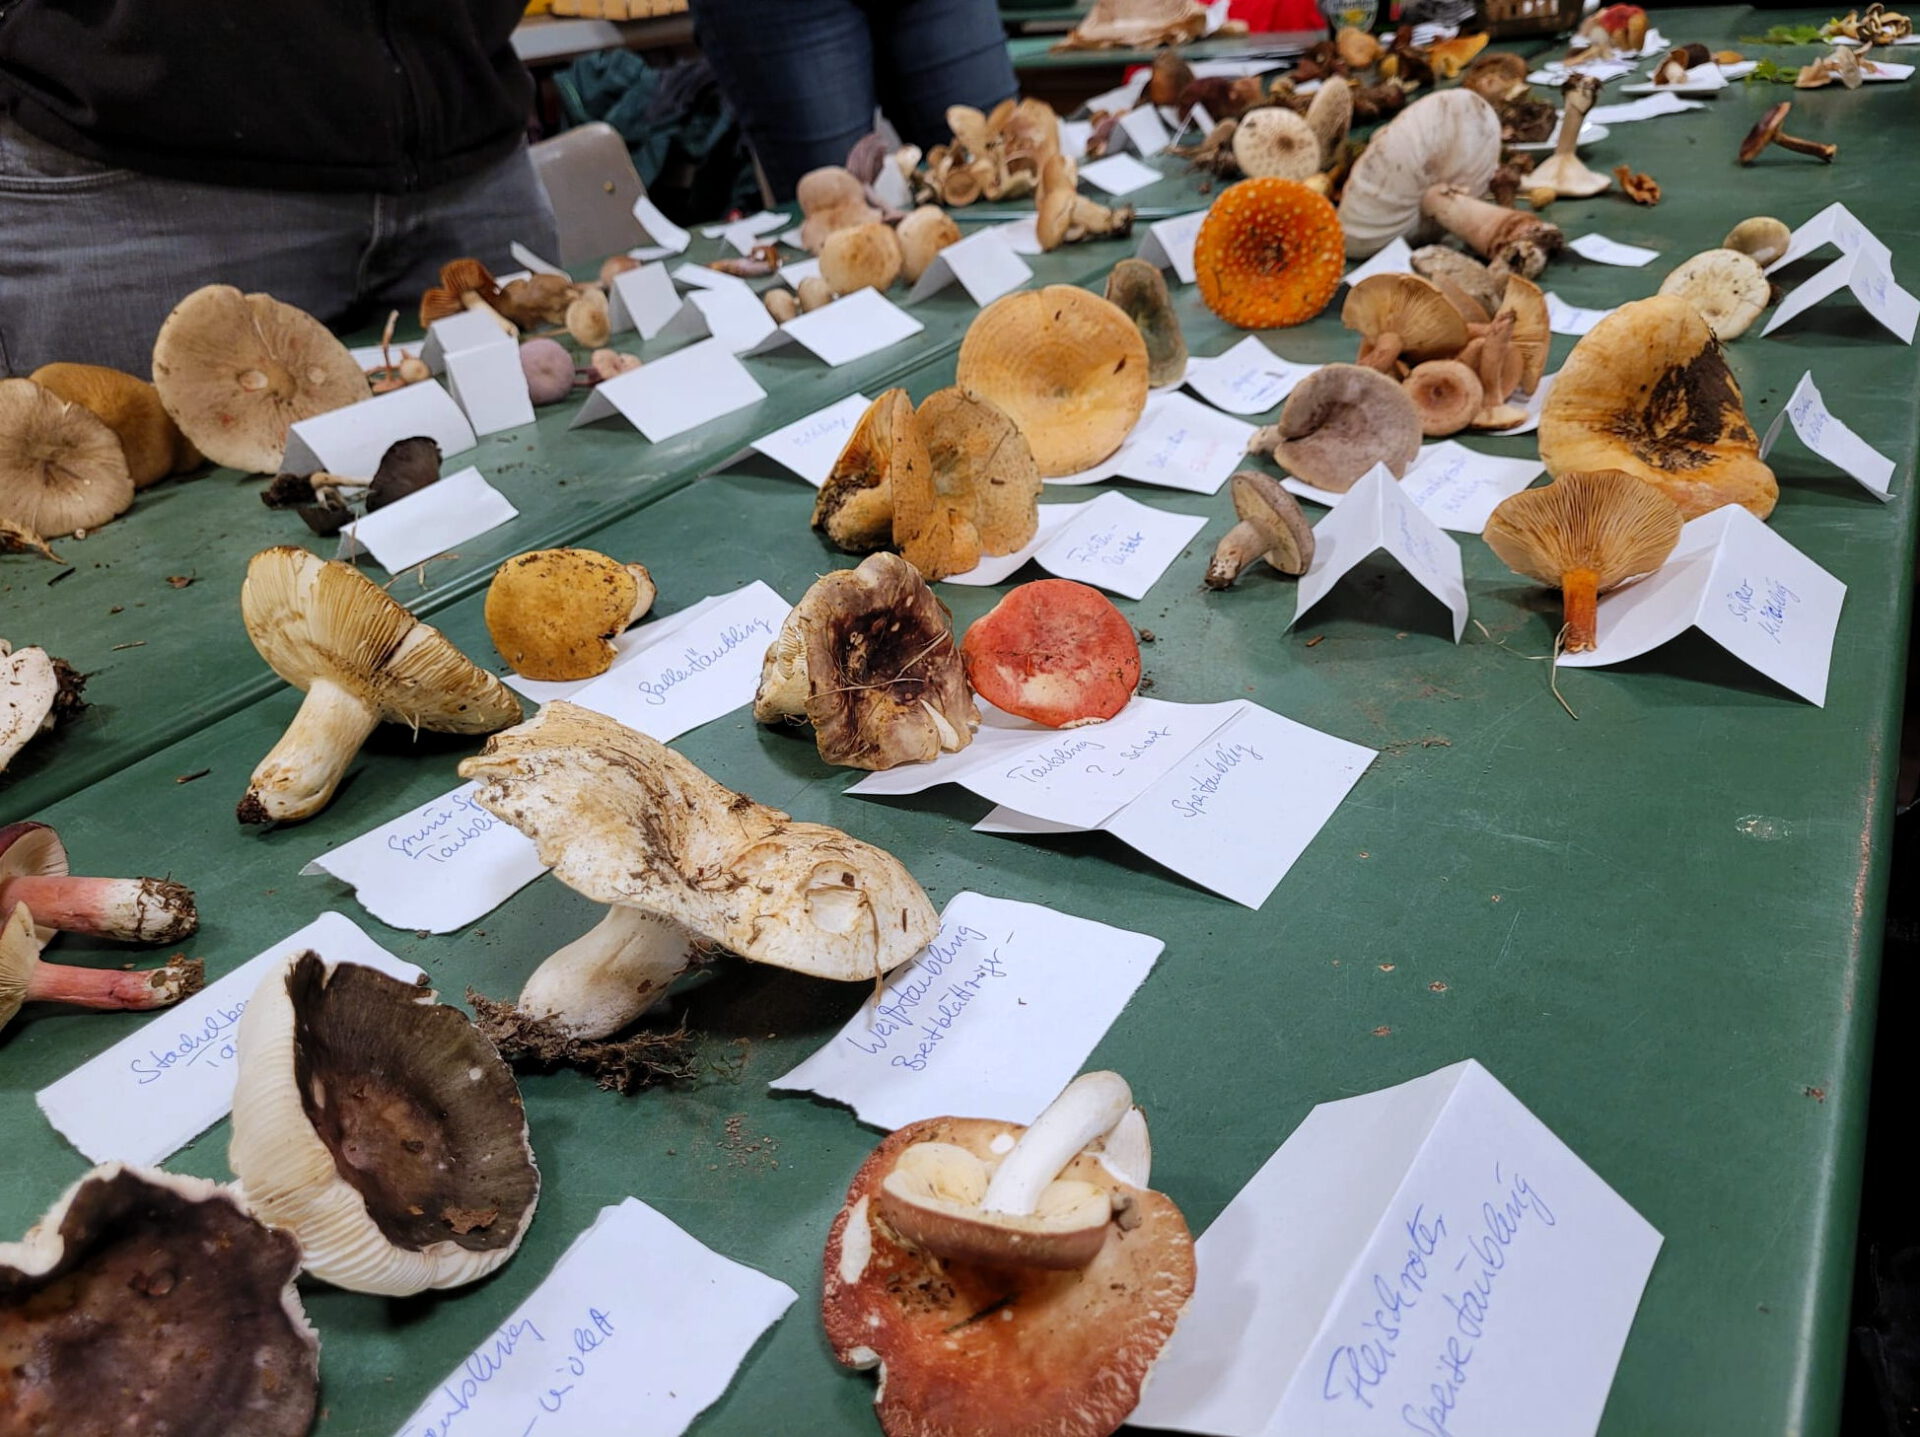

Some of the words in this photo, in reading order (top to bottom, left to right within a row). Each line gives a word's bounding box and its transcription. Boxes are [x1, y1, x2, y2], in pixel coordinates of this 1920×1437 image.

[452, 793, 485, 812] Sp
[413, 811, 500, 863] Täubli
[131, 999, 250, 1085] Stachelbe
